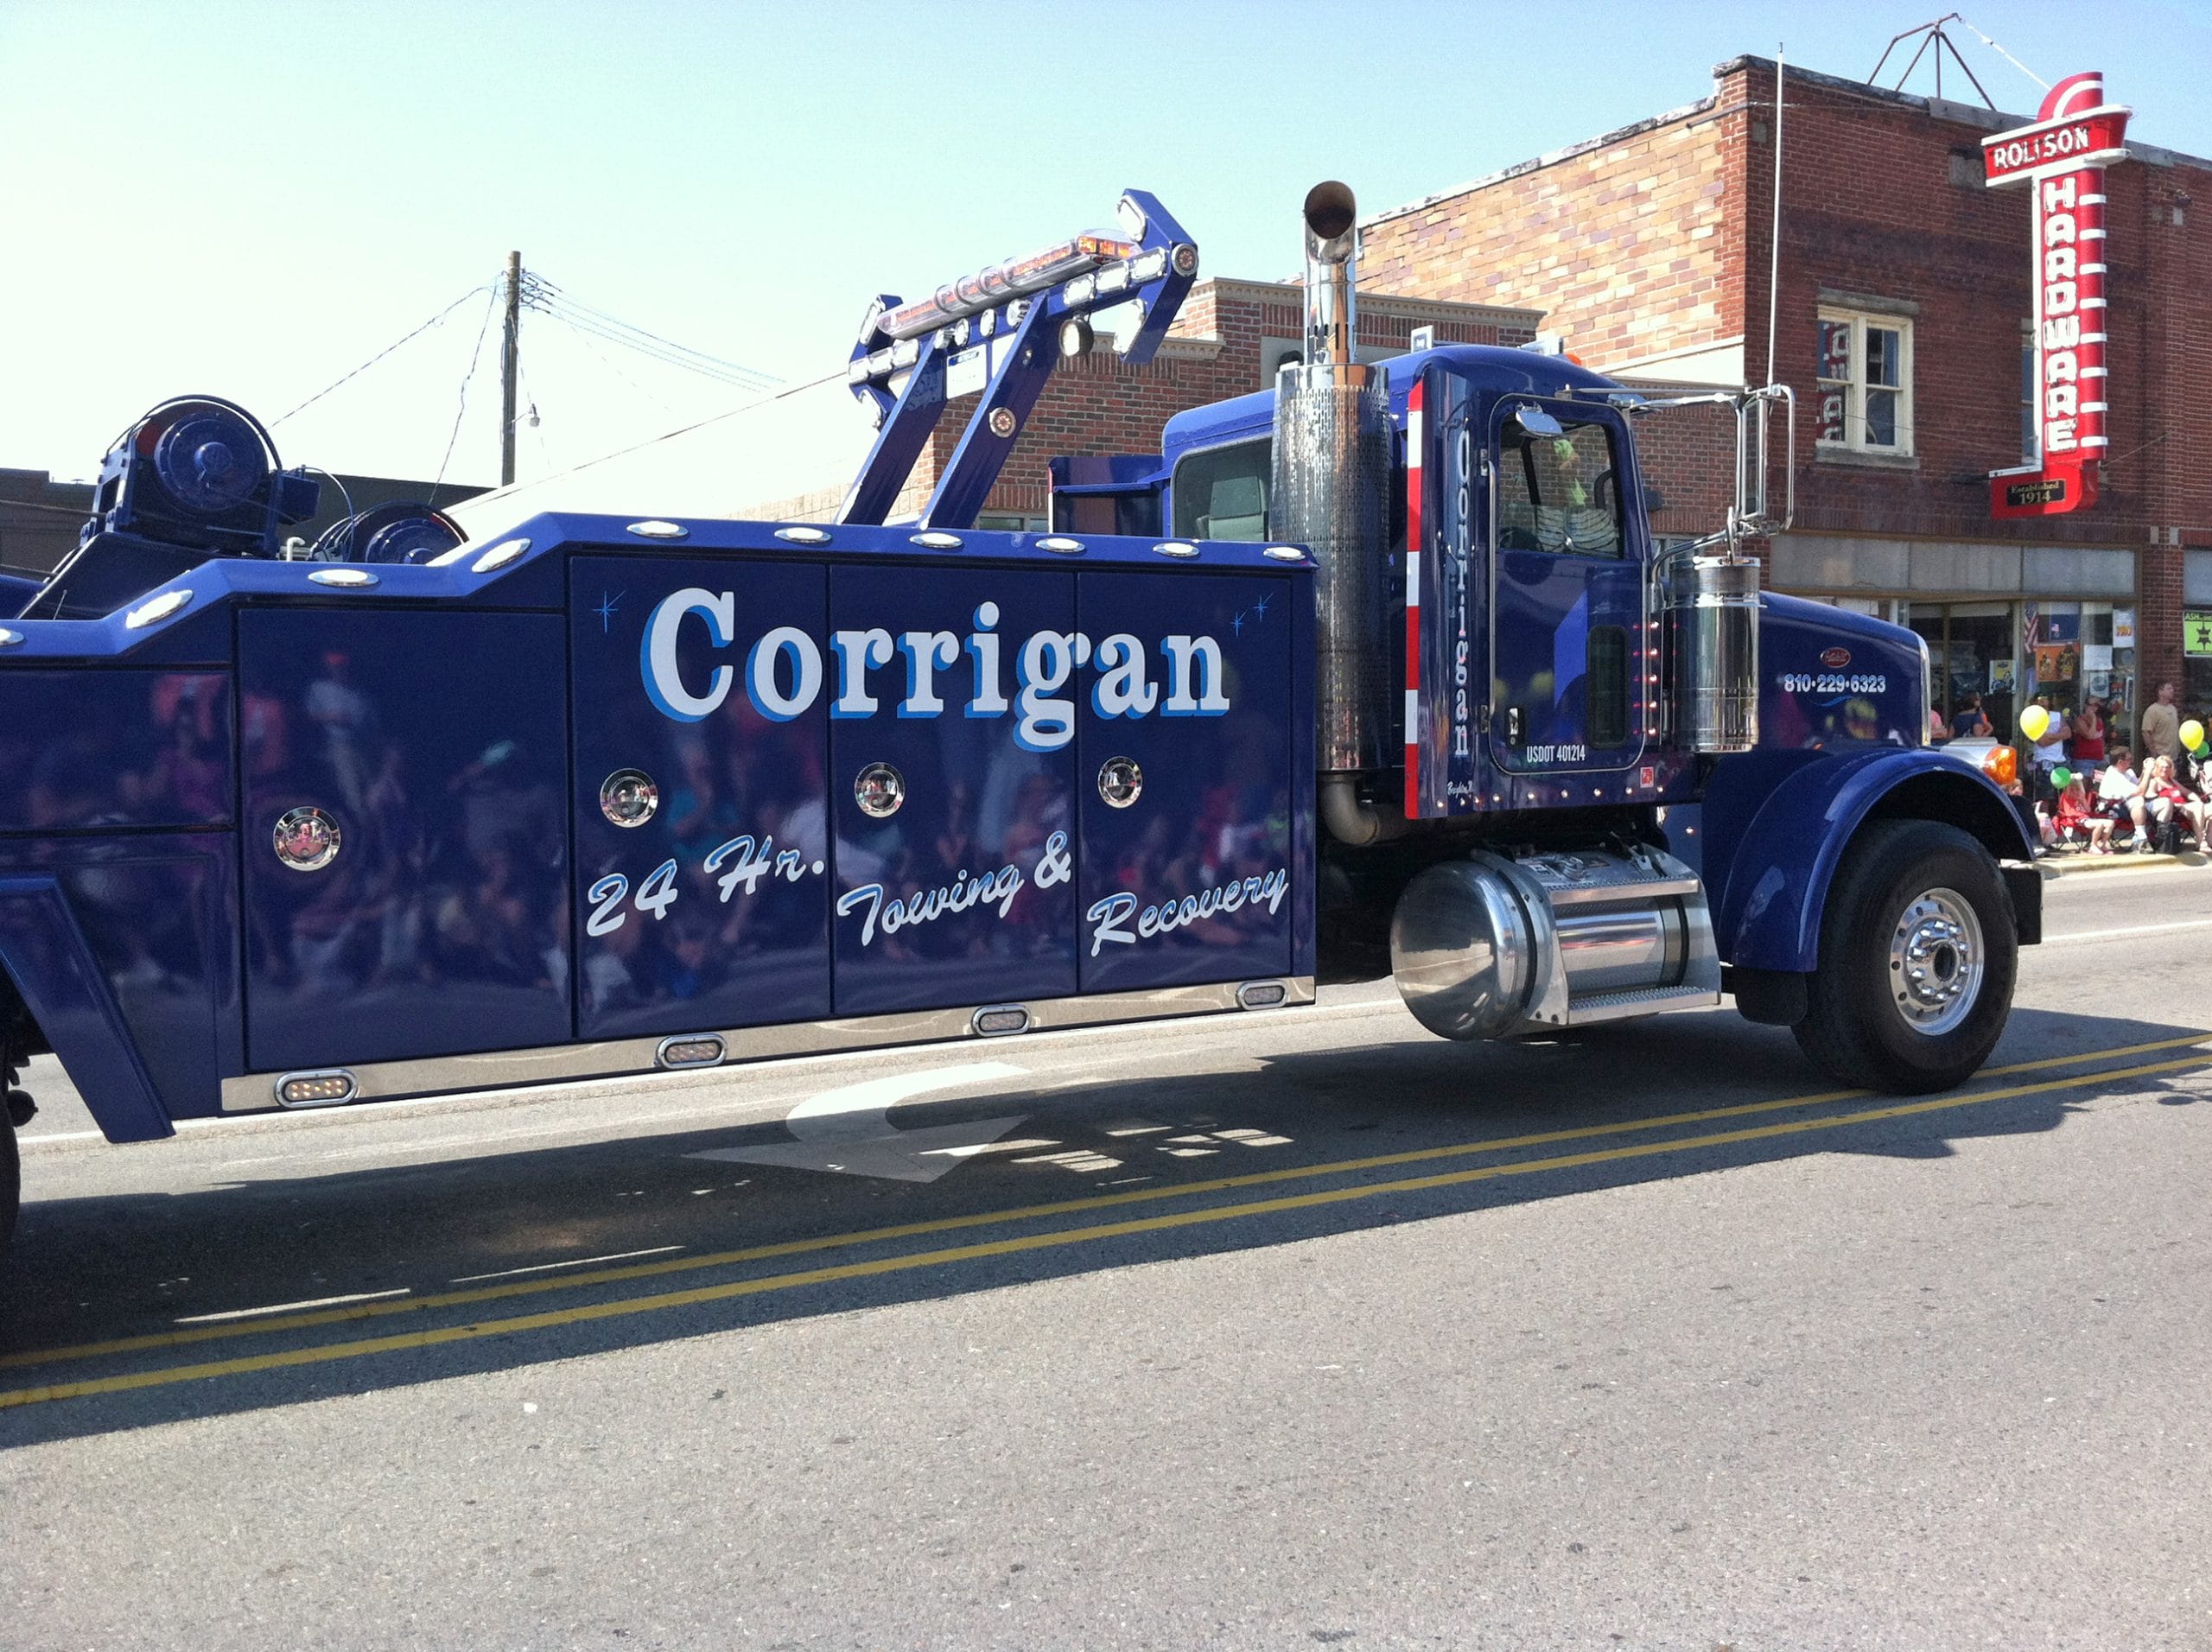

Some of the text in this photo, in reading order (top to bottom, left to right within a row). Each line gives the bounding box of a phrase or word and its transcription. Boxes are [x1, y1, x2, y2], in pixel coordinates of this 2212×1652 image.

[1993, 127, 2088, 168] ROLISON
[2044, 177, 2080, 453] HARDWARE
[2011, 480, 2059, 493] Established
[2019, 489, 2051, 504] 1914
[1455, 430, 1469, 757] Corrigan
[640, 587, 1230, 753] Corrigan
[1526, 745, 1586, 763] USDOT 401214
[587, 829, 1289, 957] 24 Hr. Towing & Recovery
